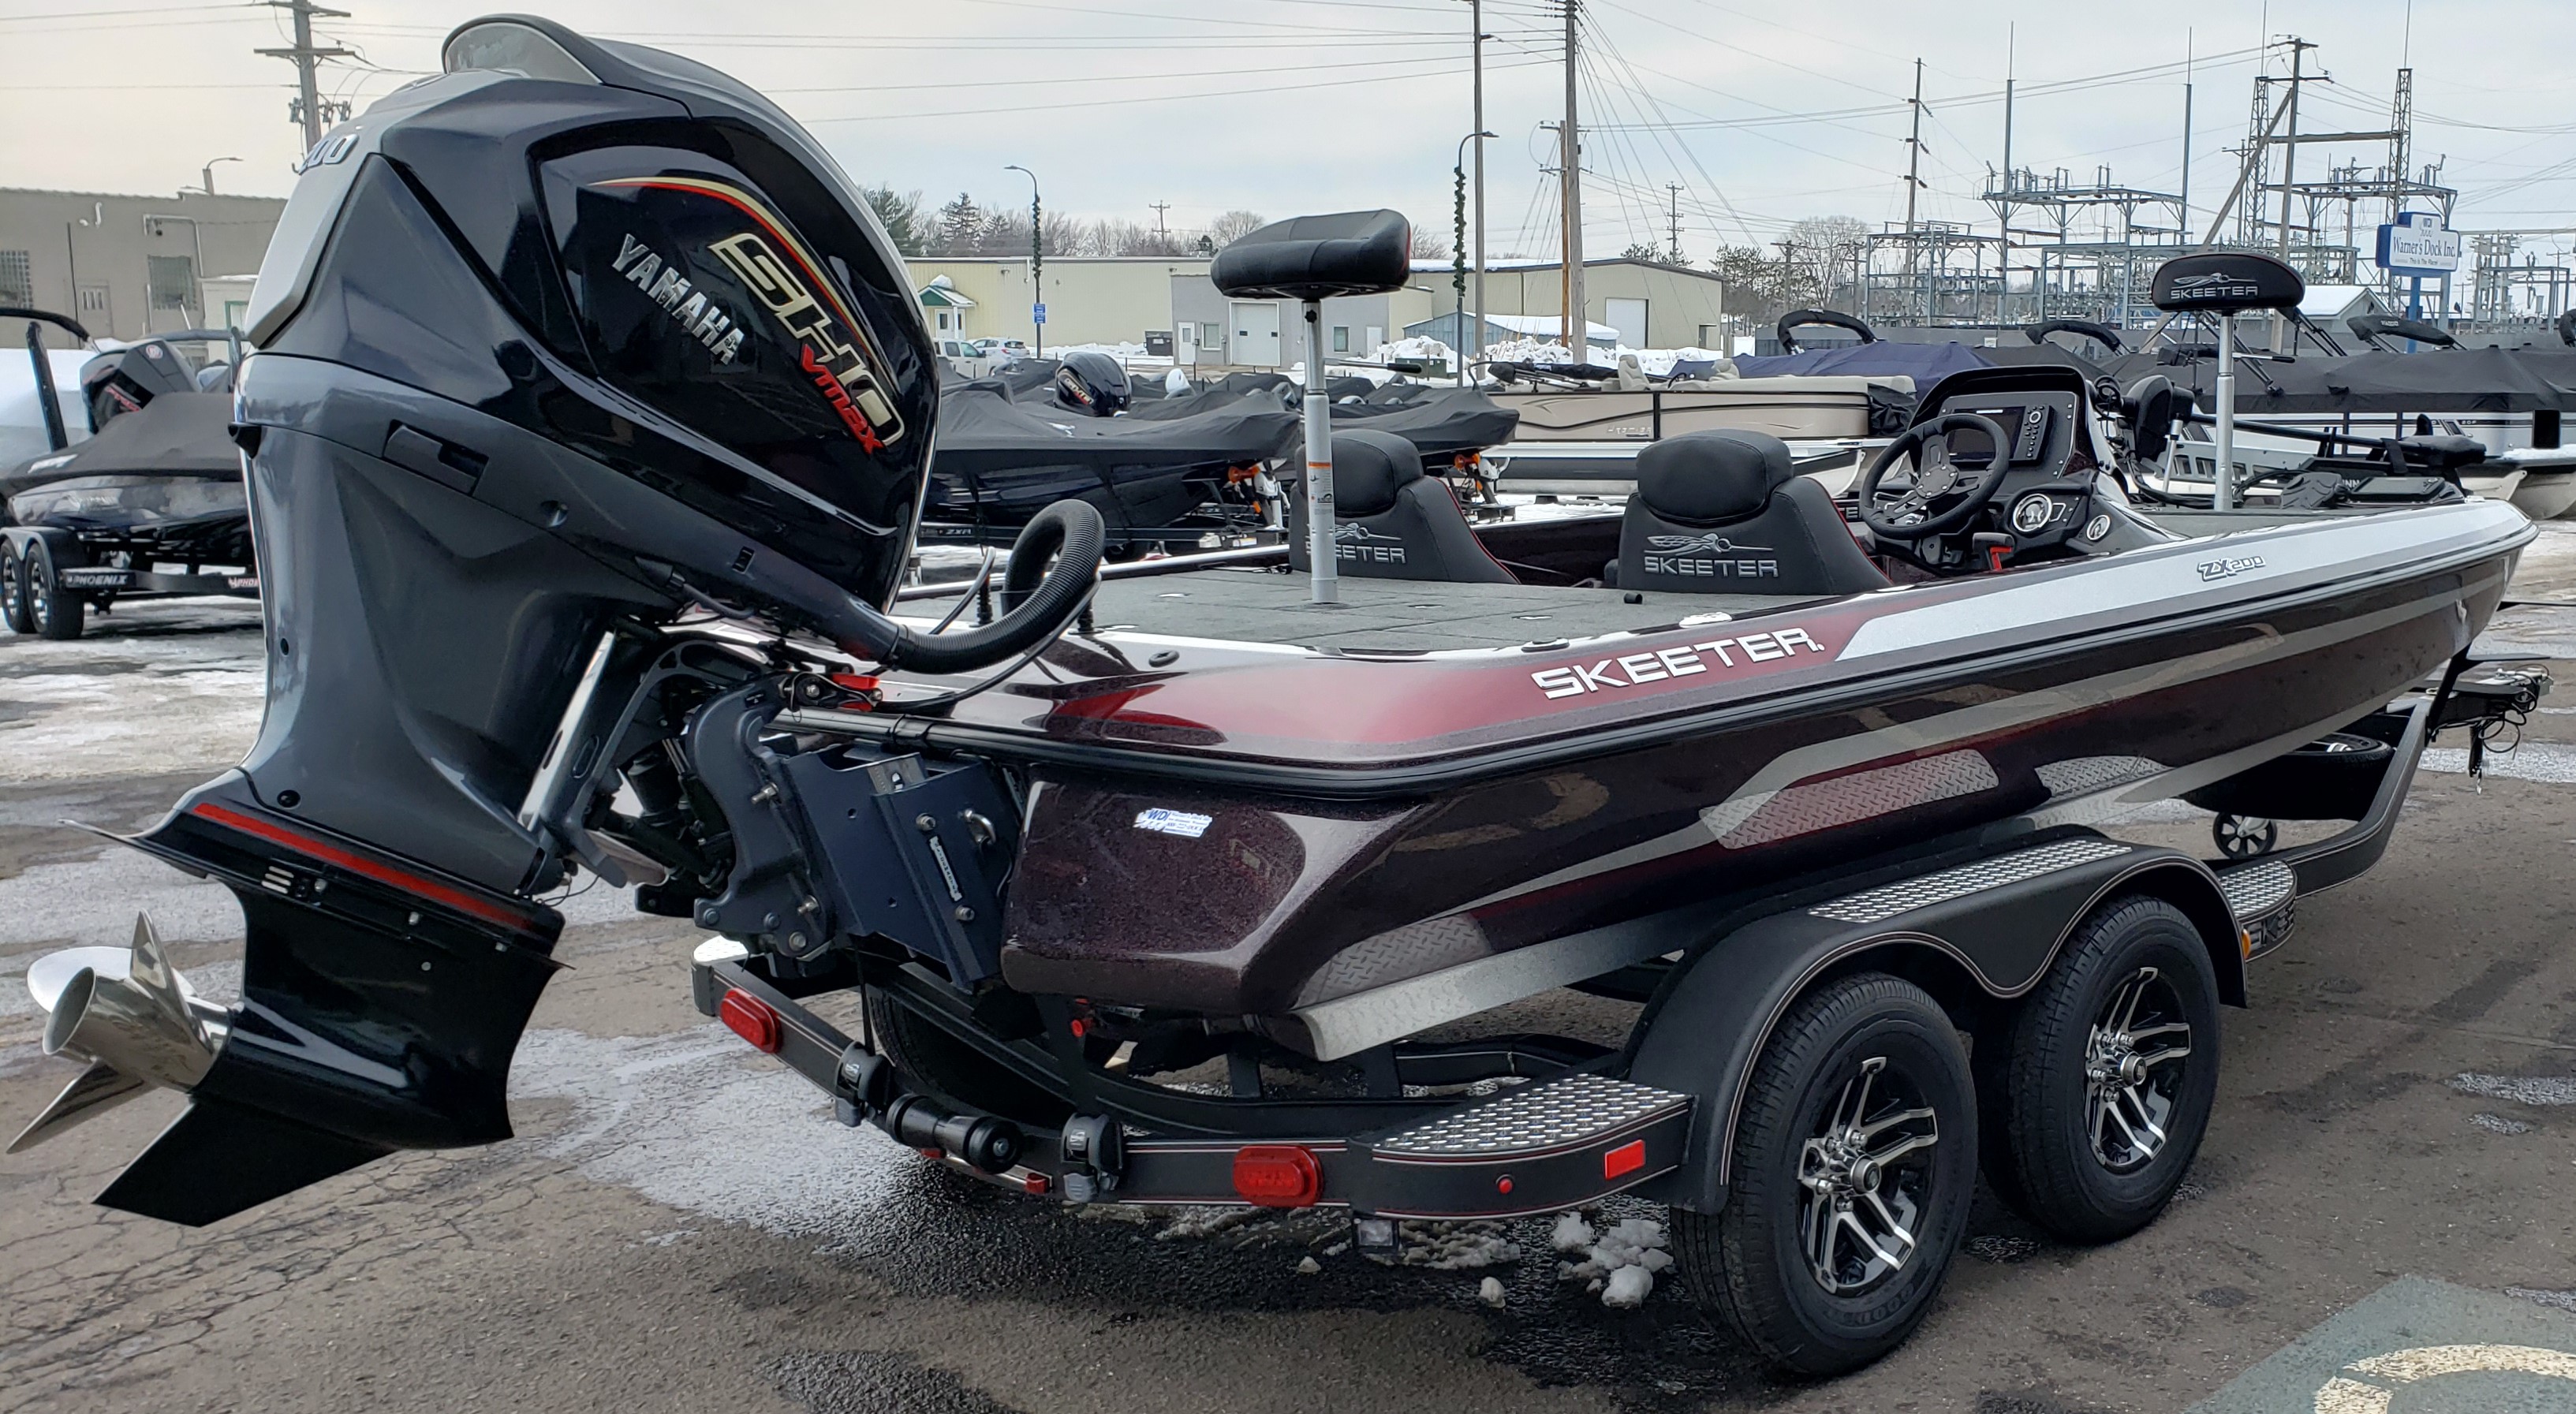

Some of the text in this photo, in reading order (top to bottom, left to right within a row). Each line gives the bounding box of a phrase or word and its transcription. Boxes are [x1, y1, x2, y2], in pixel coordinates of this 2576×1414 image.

[2393, 237, 2456, 257] Warner's Dock Inc.
[611, 233, 745, 366] YAMAHA
[2170, 285, 2259, 300] SKEETER
[707, 233, 905, 447] SHO
[1305, 541, 1406, 564] SEETER
[1644, 556, 1779, 578] SKEETER
[74, 574, 129, 585] PHOENIX
